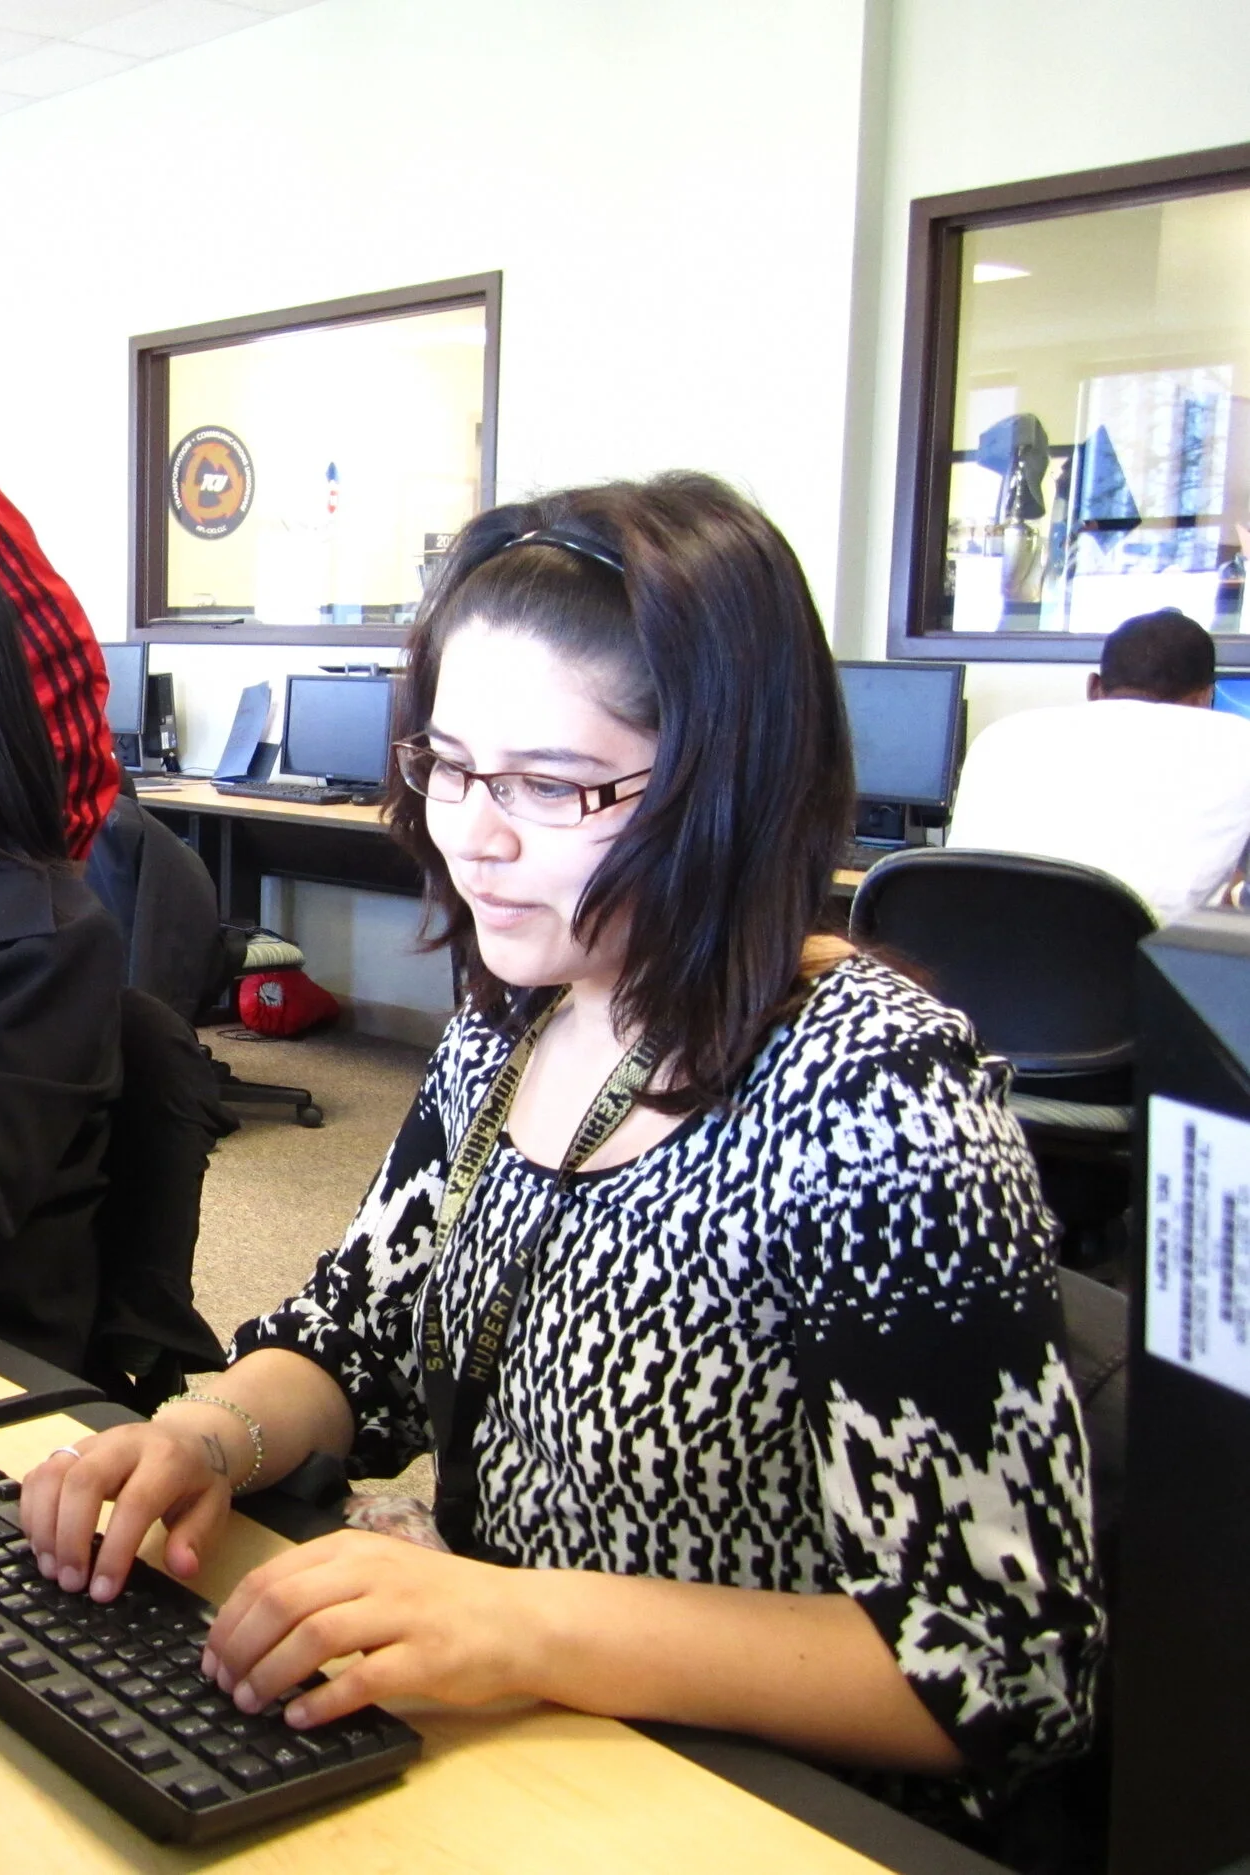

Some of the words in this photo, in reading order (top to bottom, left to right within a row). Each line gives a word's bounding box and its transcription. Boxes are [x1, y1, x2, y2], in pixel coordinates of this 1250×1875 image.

[171, 440, 192, 510] TRANSPORTATION
[196, 430, 249, 468] COMMUNICATIONS
[200, 473, 228, 492] TCU
[424, 1302, 445, 1371] ORPS
[467, 1283, 512, 1381] HUBERT
[513, 1246, 533, 1268] H.
